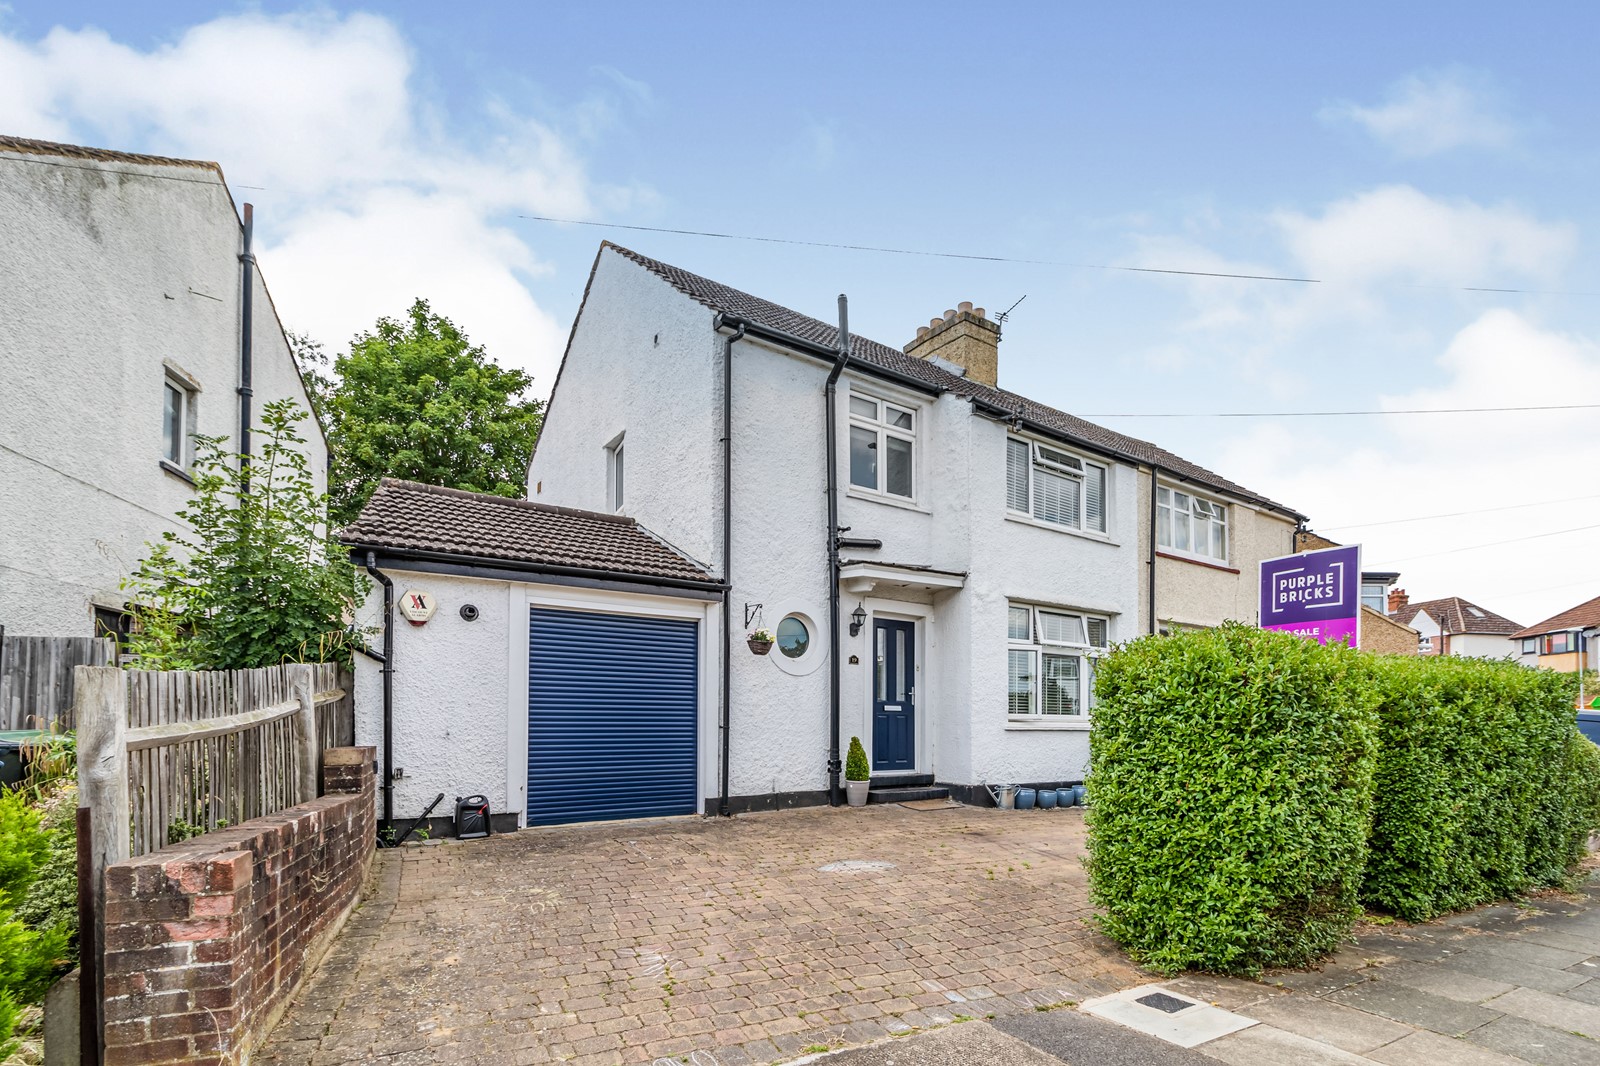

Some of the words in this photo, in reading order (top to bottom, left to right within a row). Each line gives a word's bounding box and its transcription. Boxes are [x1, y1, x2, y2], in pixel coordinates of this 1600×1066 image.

[1280, 572, 1334, 590] PURPLE
[1280, 586, 1334, 603] BRICKS
[1293, 627, 1320, 636] SALE
